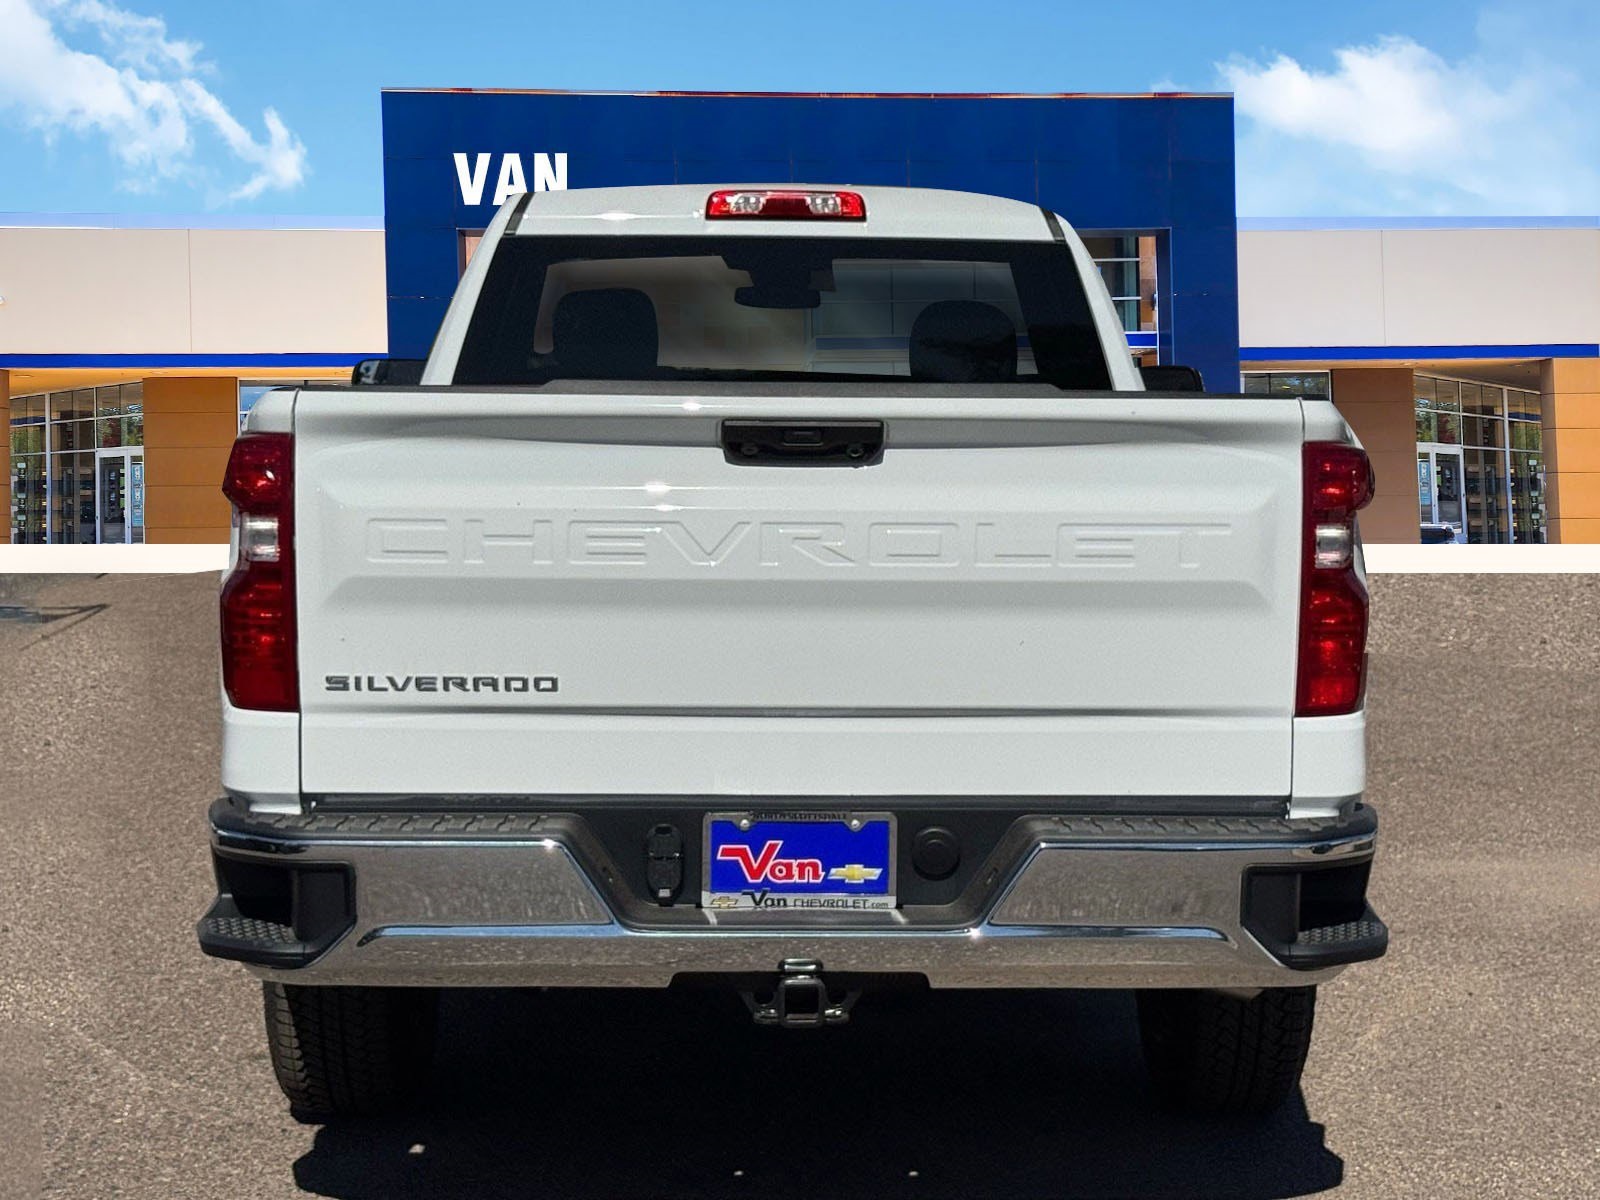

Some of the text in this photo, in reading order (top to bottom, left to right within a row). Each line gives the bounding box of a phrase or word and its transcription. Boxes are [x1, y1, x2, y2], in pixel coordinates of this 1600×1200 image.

[453, 153, 567, 205] VAN
[366, 517, 1232, 568] CHEVROLET
[325, 675, 559, 692] SILVERADO
[717, 840, 824, 883] Van
[741, 888, 788, 909] Van
